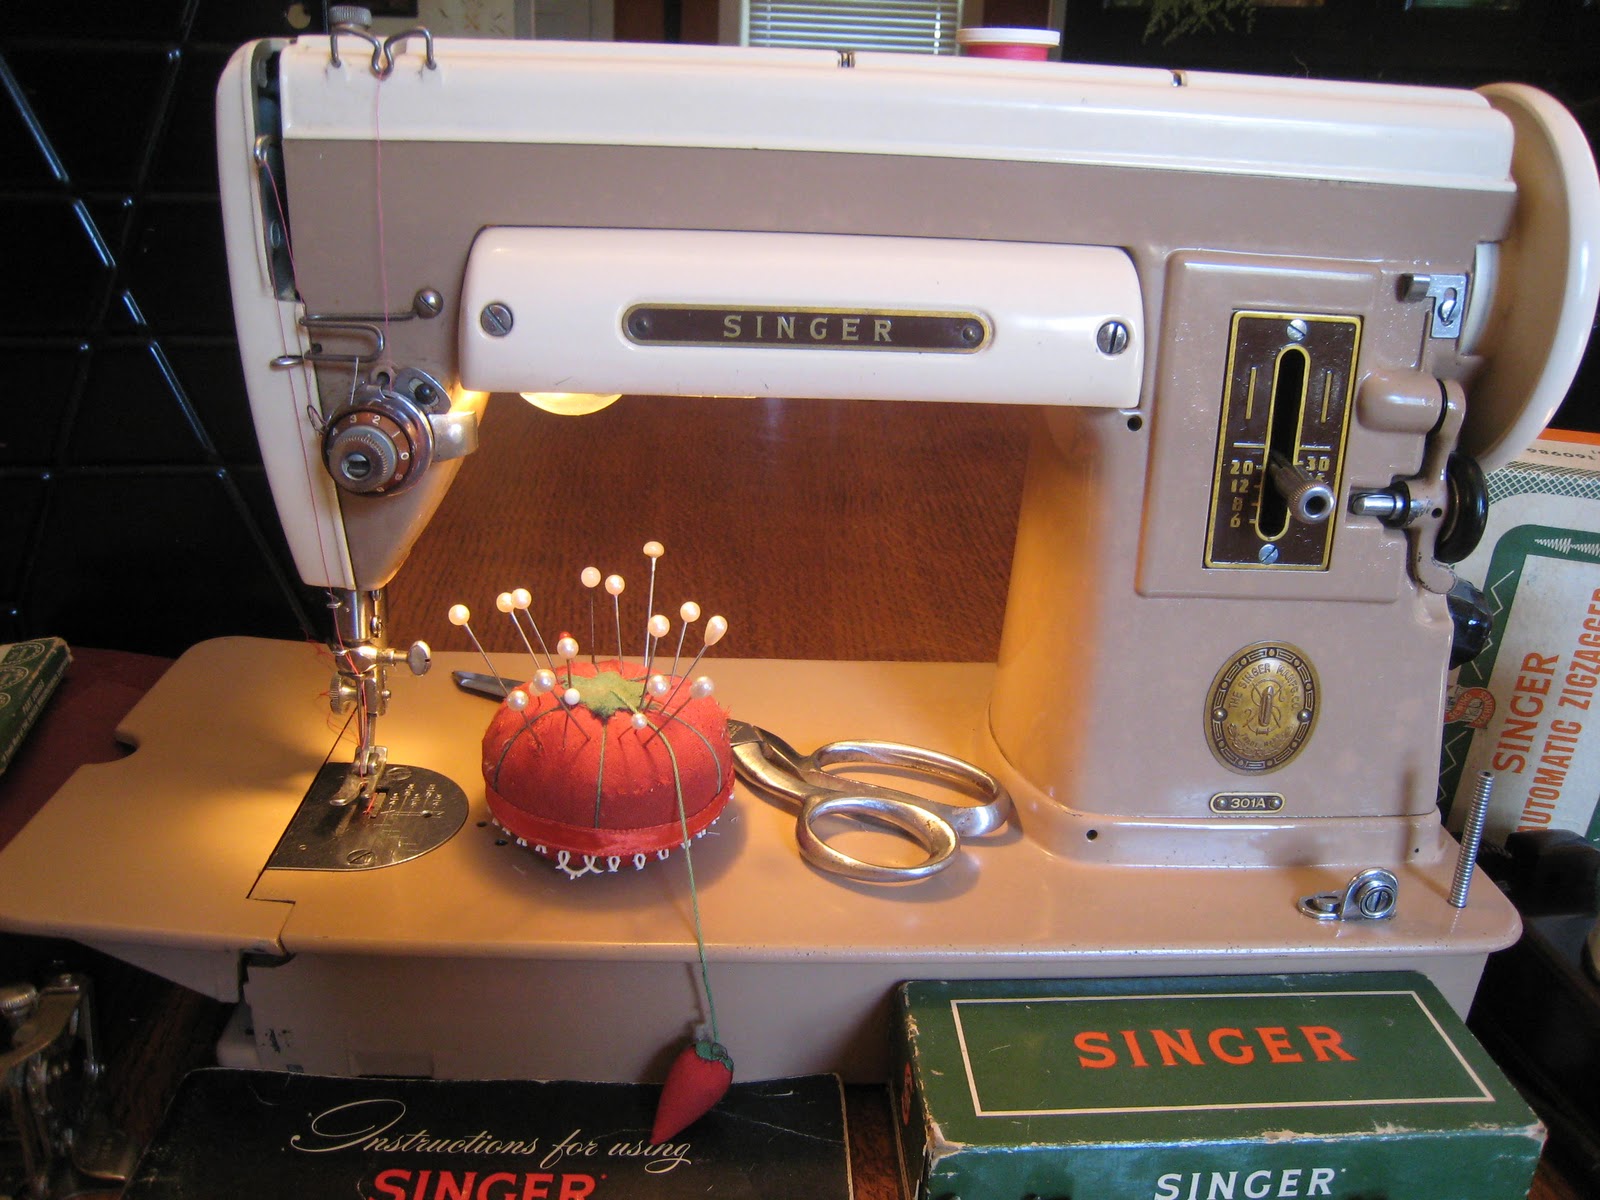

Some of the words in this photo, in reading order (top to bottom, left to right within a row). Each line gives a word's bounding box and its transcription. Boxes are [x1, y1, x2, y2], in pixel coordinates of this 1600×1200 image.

[723, 315, 892, 342] SINGER
[350, 414, 357, 424] 3
[372, 414, 381, 425] 2
[401, 452, 410, 460] 0
[1230, 459, 1254, 475] 20
[1306, 455, 1331, 471] 30
[1231, 479, 1249, 493] 12
[1232, 497, 1243, 511] 8
[1230, 513, 1241, 528] 6
[1228, 691, 1244, 709] THE
[1239, 663, 1271, 687] SINGER
[1492, 651, 1560, 774] SINGER
[1231, 798, 1266, 809] 301A
[1073, 1025, 1357, 1069] SINGER
[290, 1099, 538, 1155] Instructions
[540, 1128, 599, 1170] for
[608, 1137, 692, 1173] using
[369, 1169, 596, 1200] SINGER
[1154, 1168, 1336, 1200] SINGER
